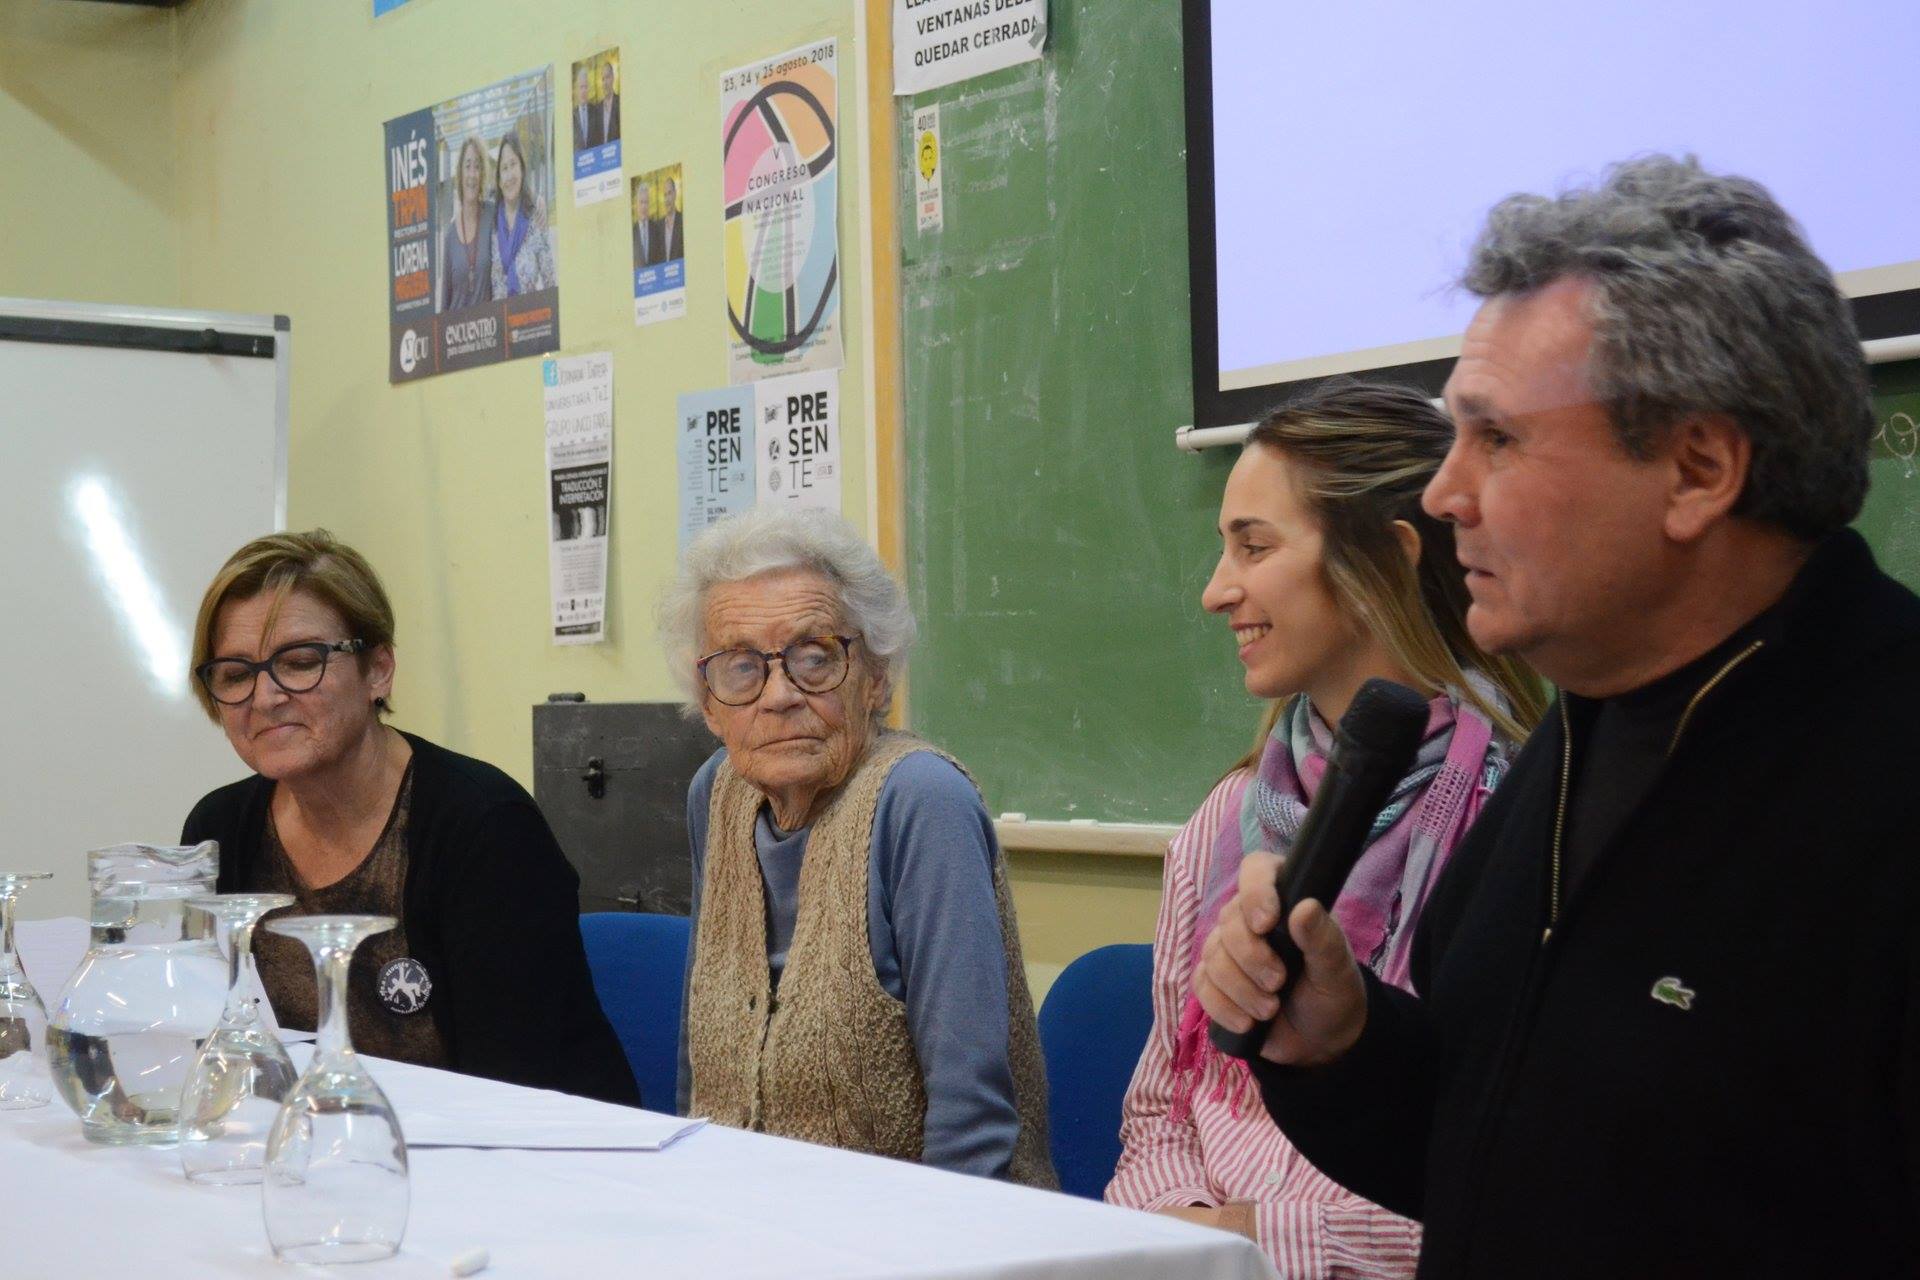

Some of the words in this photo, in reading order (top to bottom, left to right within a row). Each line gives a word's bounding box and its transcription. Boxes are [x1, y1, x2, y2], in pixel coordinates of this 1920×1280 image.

[916, 0, 990, 36] VENTANAS
[914, 37, 970, 67] QUEDAR
[724, 77, 738, 93] 23,
[740, 72, 752, 86] 24
[755, 73, 761, 85] y
[763, 63, 774, 80] 25
[776, 56, 809, 78] agosto
[811, 44, 835, 65] 2018
[391, 129, 428, 192] INÉS
[772, 147, 781, 161] V
[747, 163, 807, 191] CONGRESO
[746, 189, 805, 216] NACIONAL
[393, 239, 429, 278] LORENA
[706, 407, 741, 436] PRE
[787, 391, 828, 425] PRE
[707, 436, 741, 465] SEN
[789, 424, 828, 457] SEN
[707, 466, 728, 494] TE
[788, 458, 813, 491] TE
